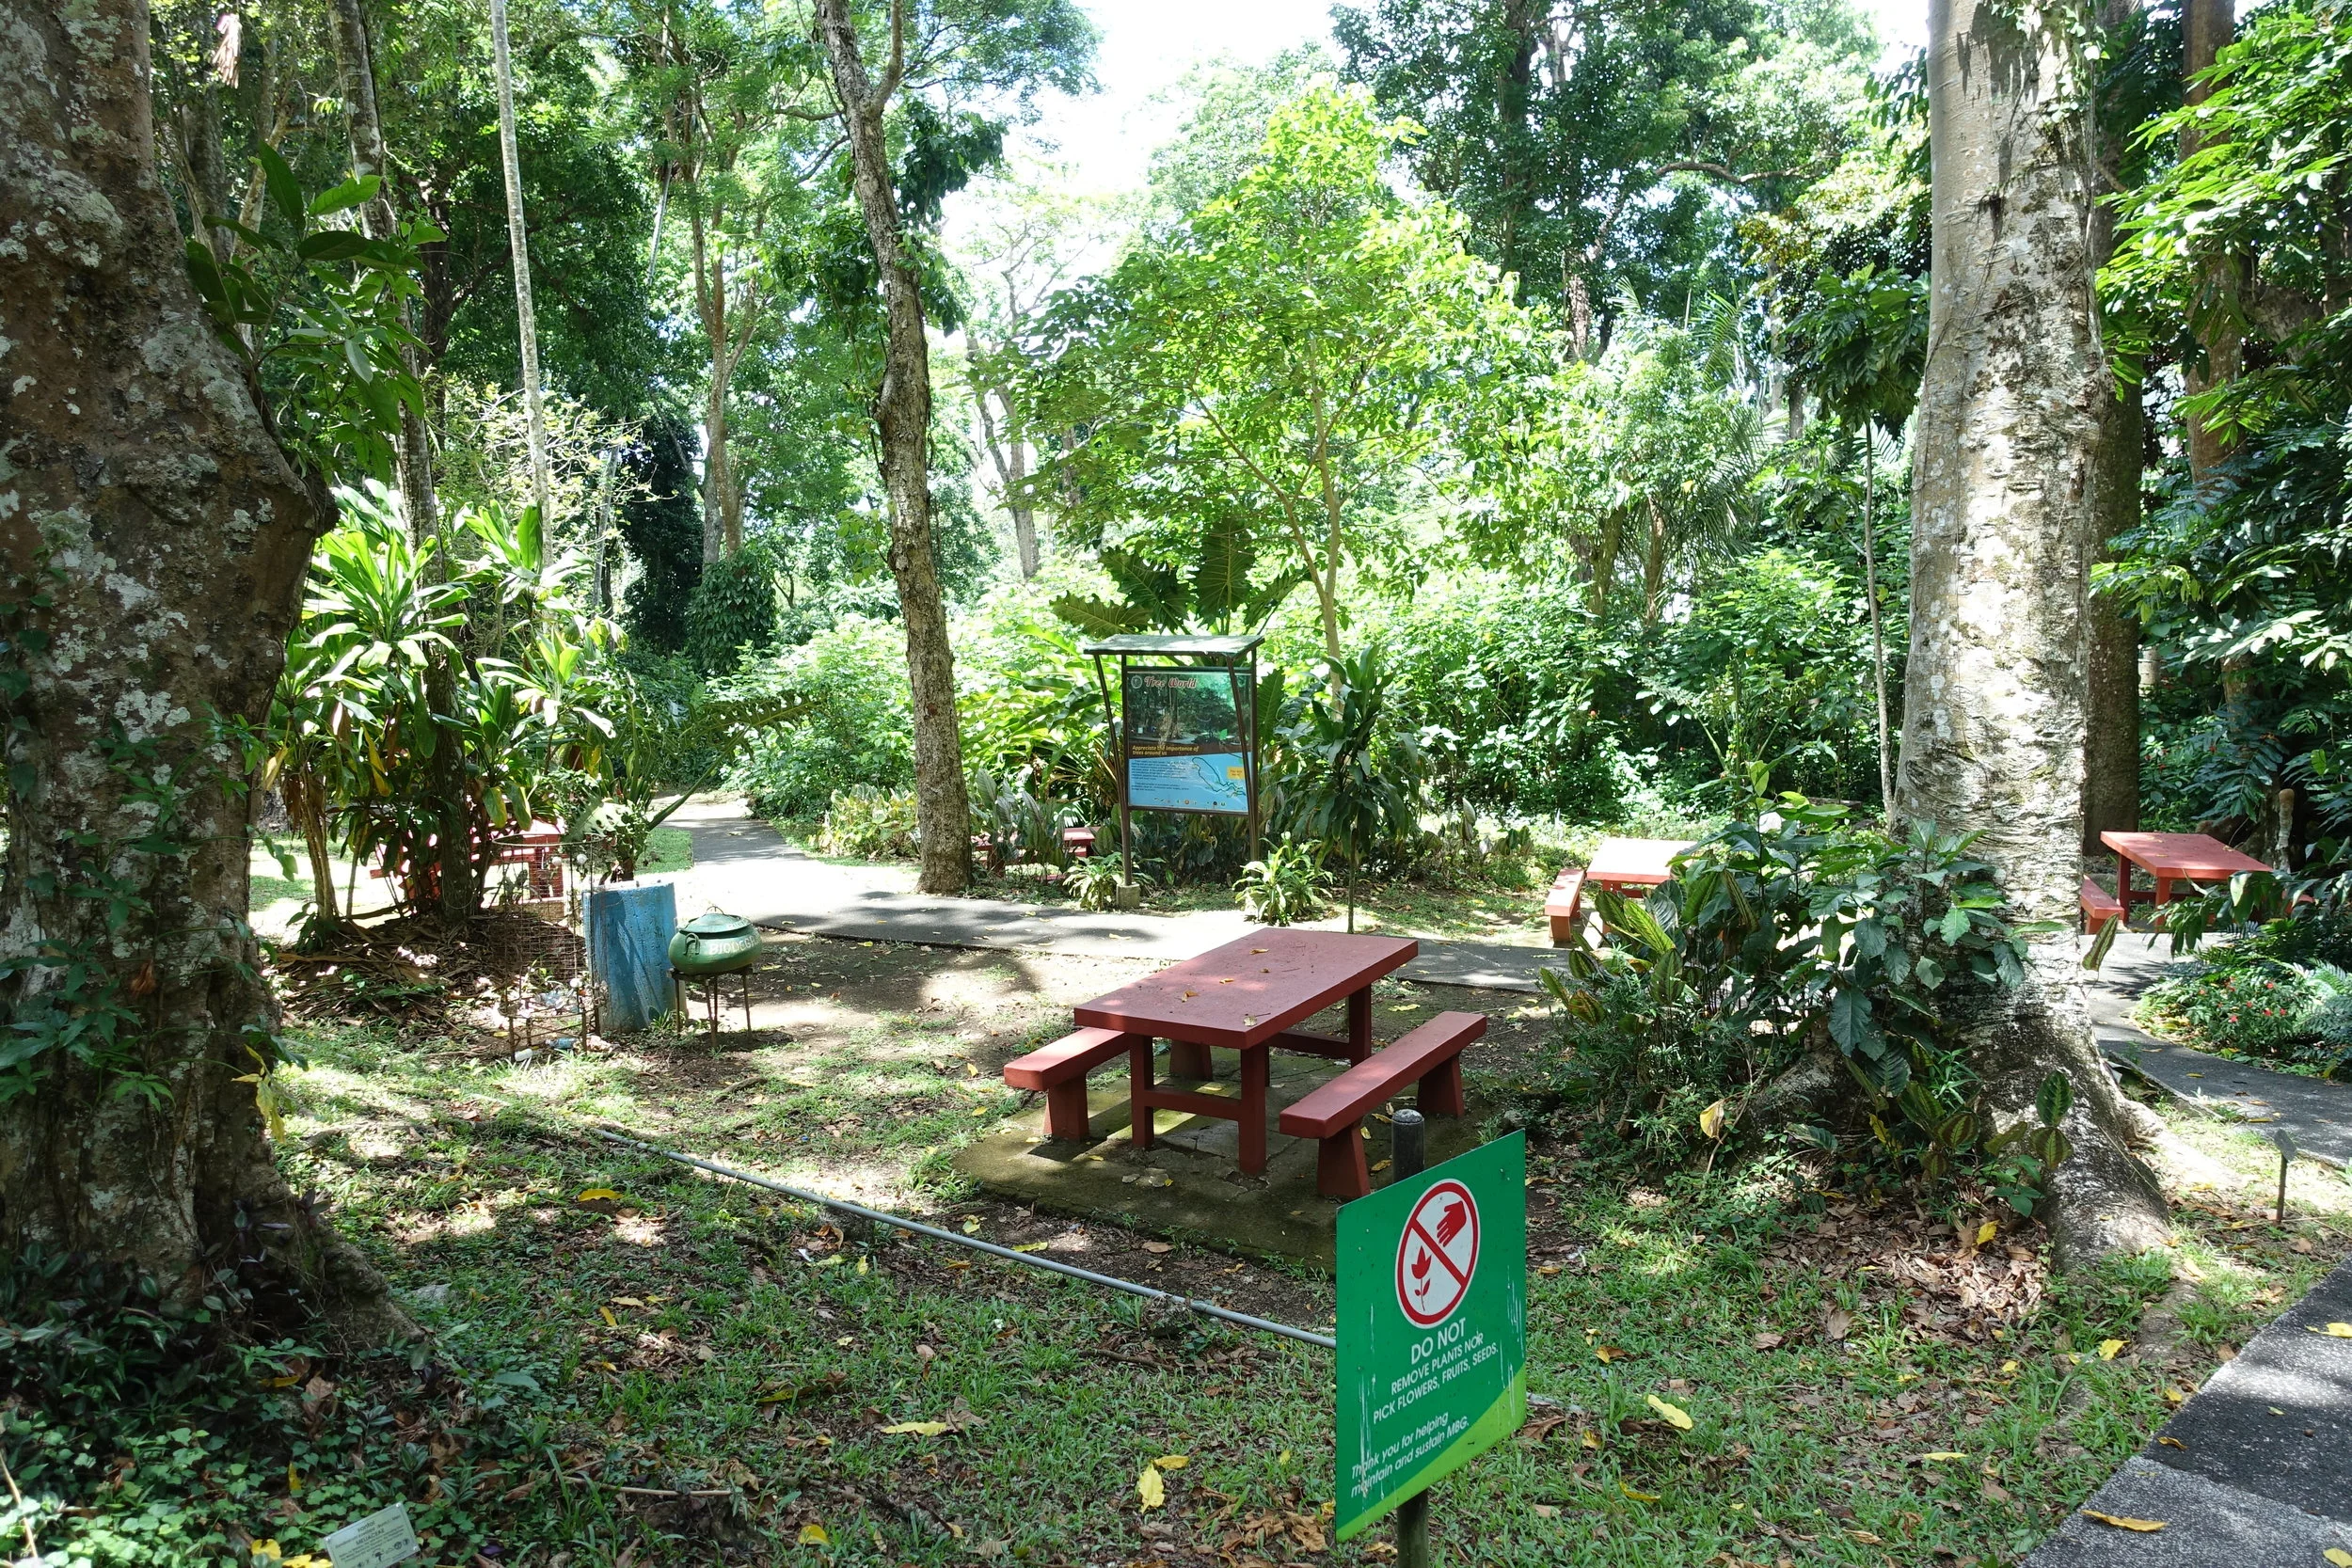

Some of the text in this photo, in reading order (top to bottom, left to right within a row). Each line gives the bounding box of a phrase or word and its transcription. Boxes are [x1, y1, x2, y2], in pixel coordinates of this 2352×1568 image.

[1144, 675, 1166, 688] Tree
[1168, 676, 1198, 689] World
[1391, 1332, 1484, 1396] REMOVE PLANTS NOR
[1410, 1317, 1466, 1365] DO NOT
[1373, 1341, 1499, 1425] PICK FLOWERS, FRUITS, SEEDS.
[1350, 1416, 1470, 1498] maintain and sustain MBG.
[1351, 1411, 1449, 1480] Thank you for helping
